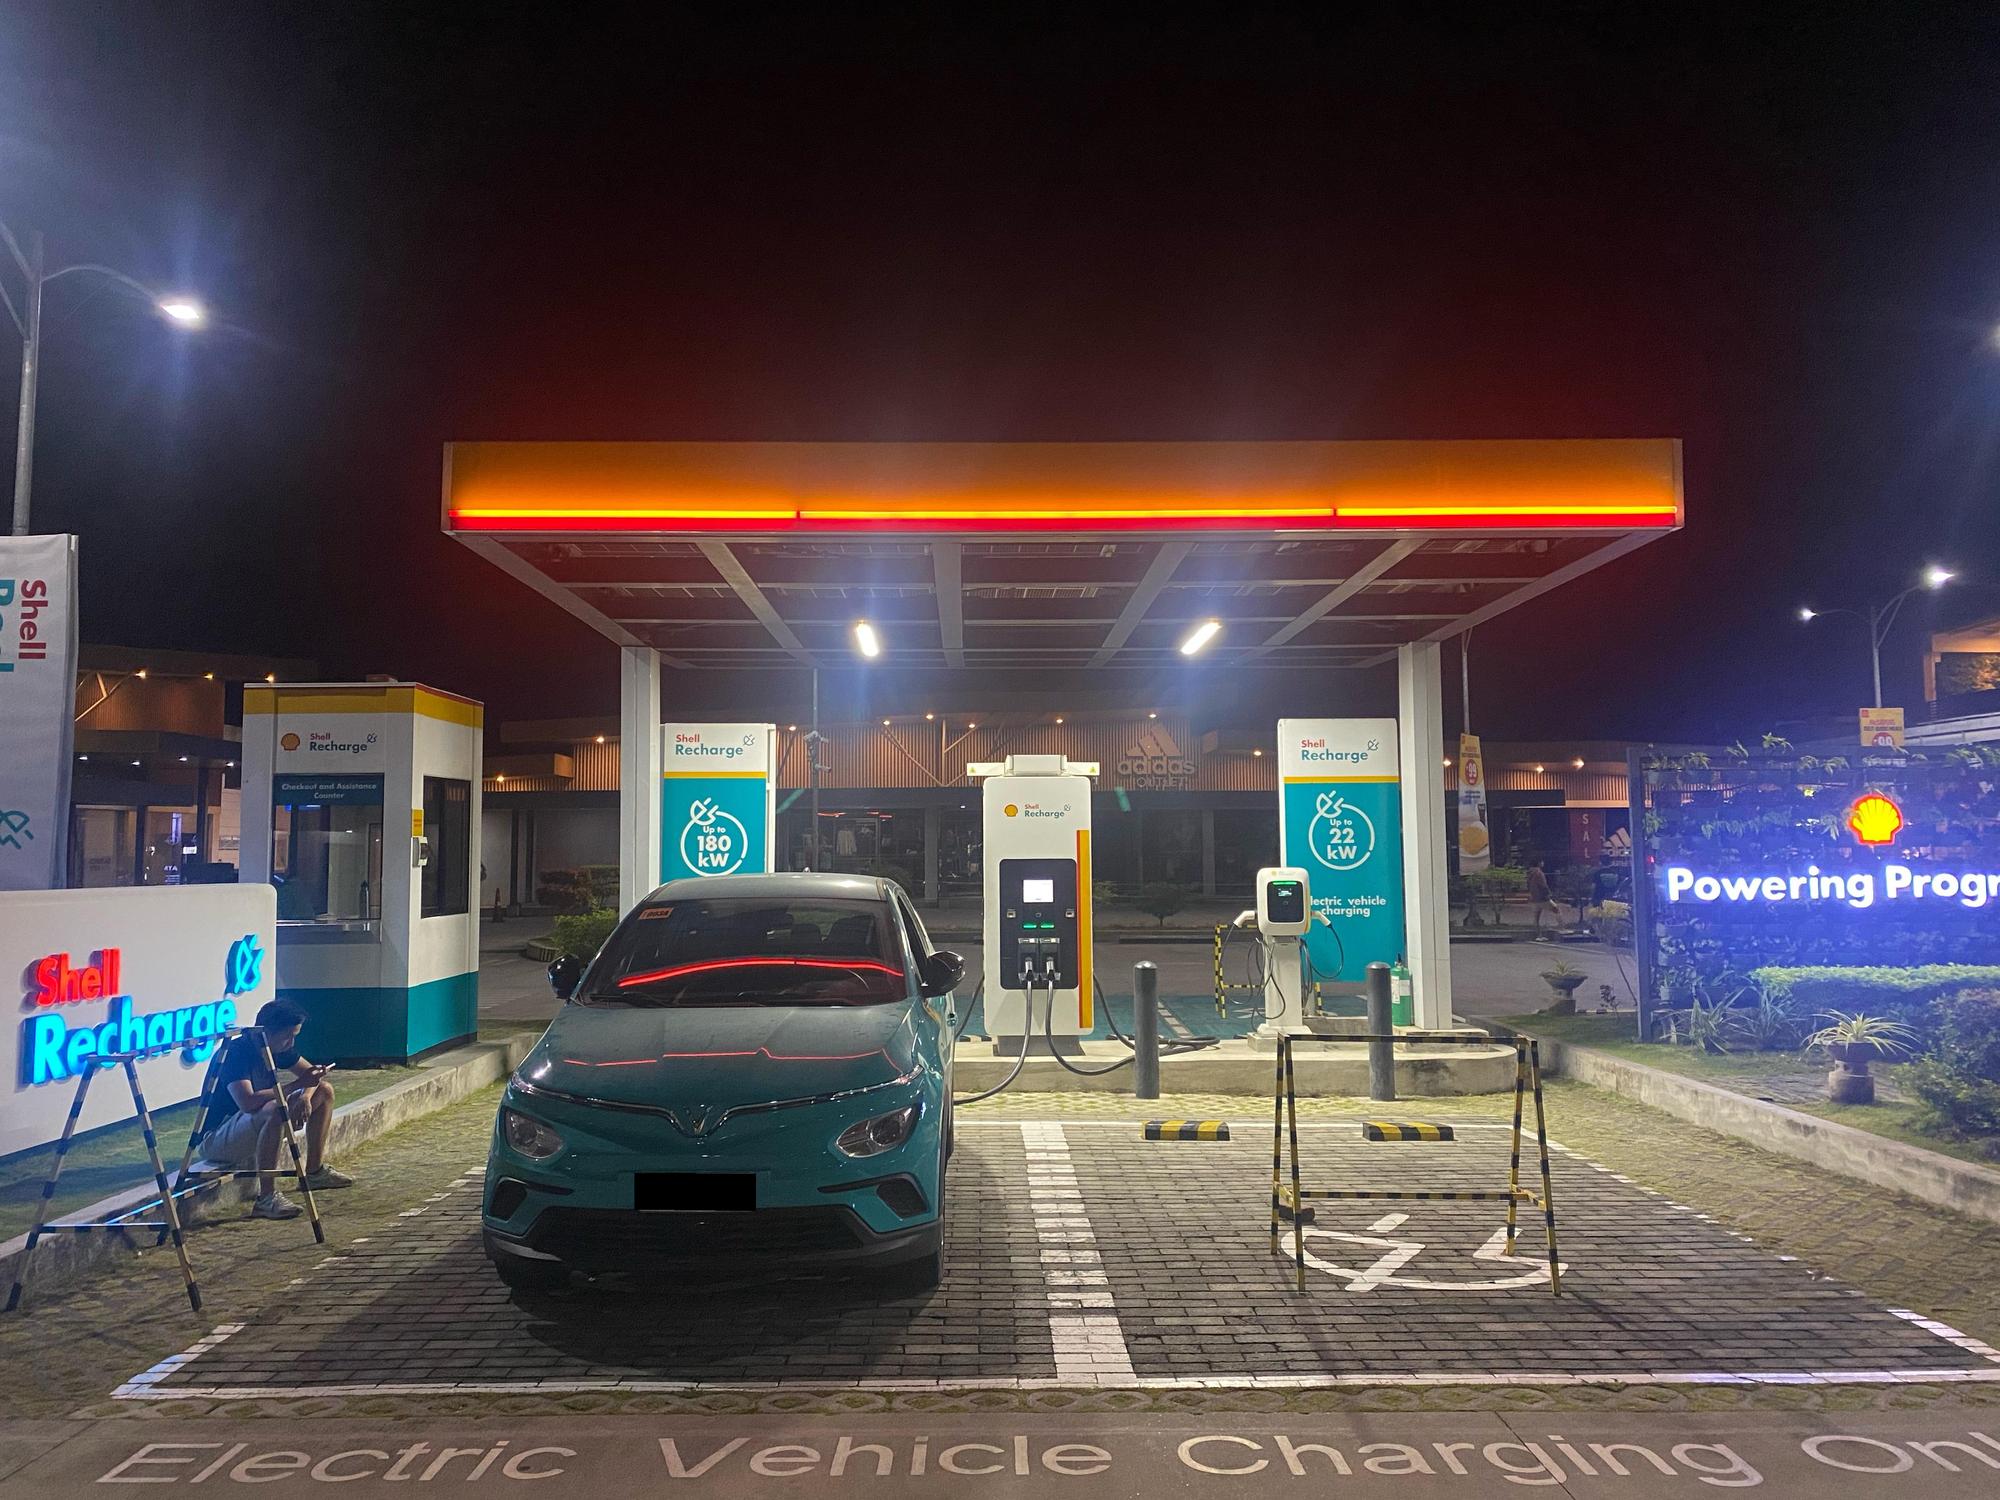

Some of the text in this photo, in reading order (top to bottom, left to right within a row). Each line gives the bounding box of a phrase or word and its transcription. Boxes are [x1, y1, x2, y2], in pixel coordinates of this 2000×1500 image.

[18, 579, 48, 660] Shell
[310, 732, 331, 741] Shell
[675, 734, 700, 743] Shell
[1301, 739, 1325, 748] Shell
[309, 741, 368, 754] Recharge
[675, 743, 744, 759] Recharge
[1301, 748, 1369, 764] Recharge
[1117, 759, 1195, 775] adidas
[281, 783, 317, 791] Checkout
[336, 783, 377, 791] Assistance
[1024, 810, 1065, 819] Recharge
[1330, 818, 1353, 827] Up to
[702, 826, 715, 835] Up
[1329, 827, 1355, 844] 22
[1582, 813, 1591, 859] SAL
[697, 835, 732, 852] 180
[698, 852, 730, 867] kW
[1327, 844, 1357, 860] kW
[1667, 865, 1875, 909] Powering
[1310, 895, 1387, 906] lectric vehicle
[1321, 905, 1371, 918] charging
[35, 947, 121, 1008] Shell
[31, 995, 238, 1085] Recharge
[95, 1440, 578, 1484] Electric
[658, 1435, 1113, 1477] Vehicle
[1177, 1435, 1764, 1487] Charging
